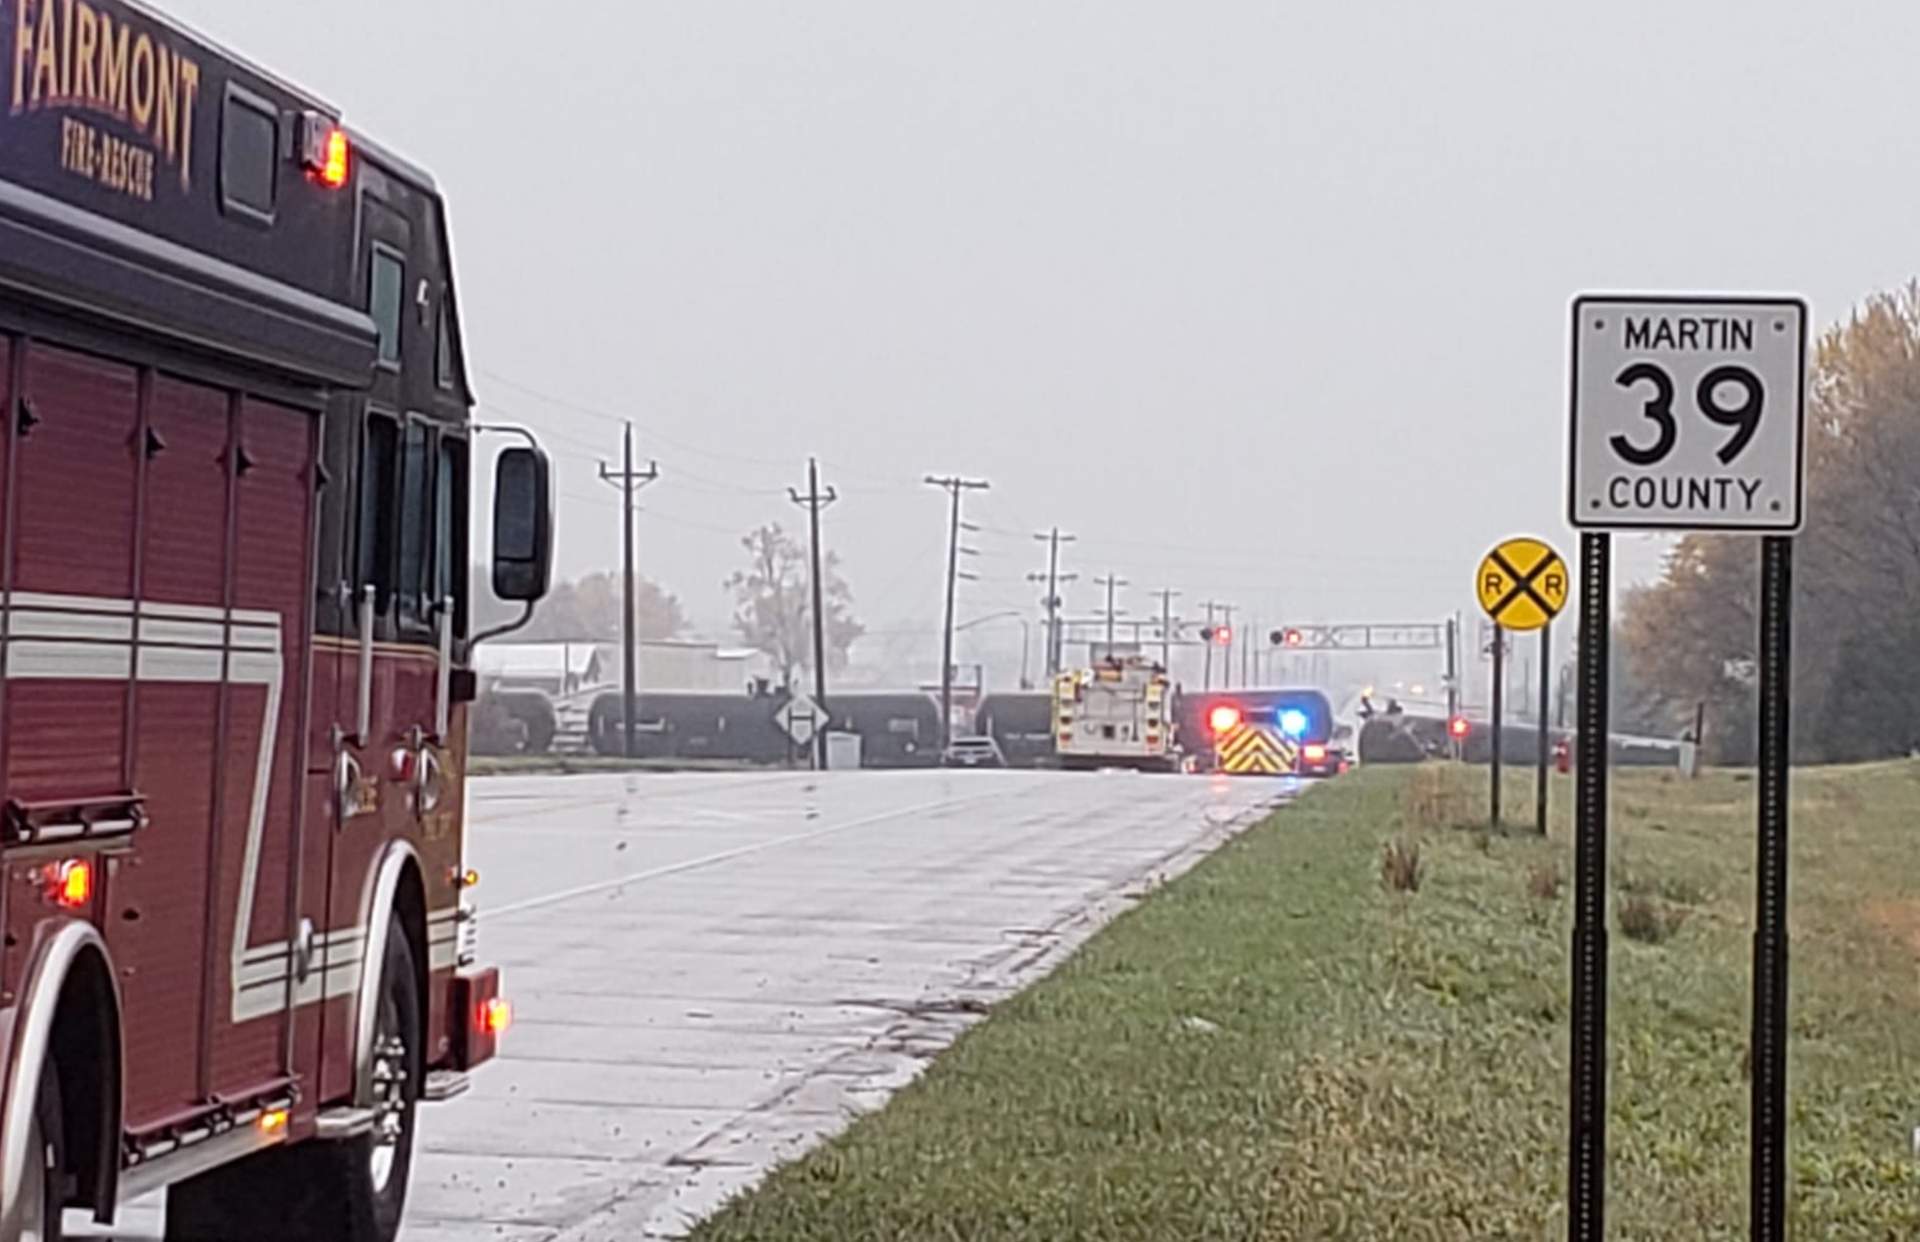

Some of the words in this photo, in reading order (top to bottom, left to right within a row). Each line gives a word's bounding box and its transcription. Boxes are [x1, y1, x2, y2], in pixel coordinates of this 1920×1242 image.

[11, 0, 200, 190] FAIRMONT
[1624, 317, 1753, 351] MARTIN
[1609, 362, 1765, 466] 39
[1608, 476, 1762, 511] COUNTY
[1485, 573, 1502, 595] R
[1545, 574, 1562, 596] R
